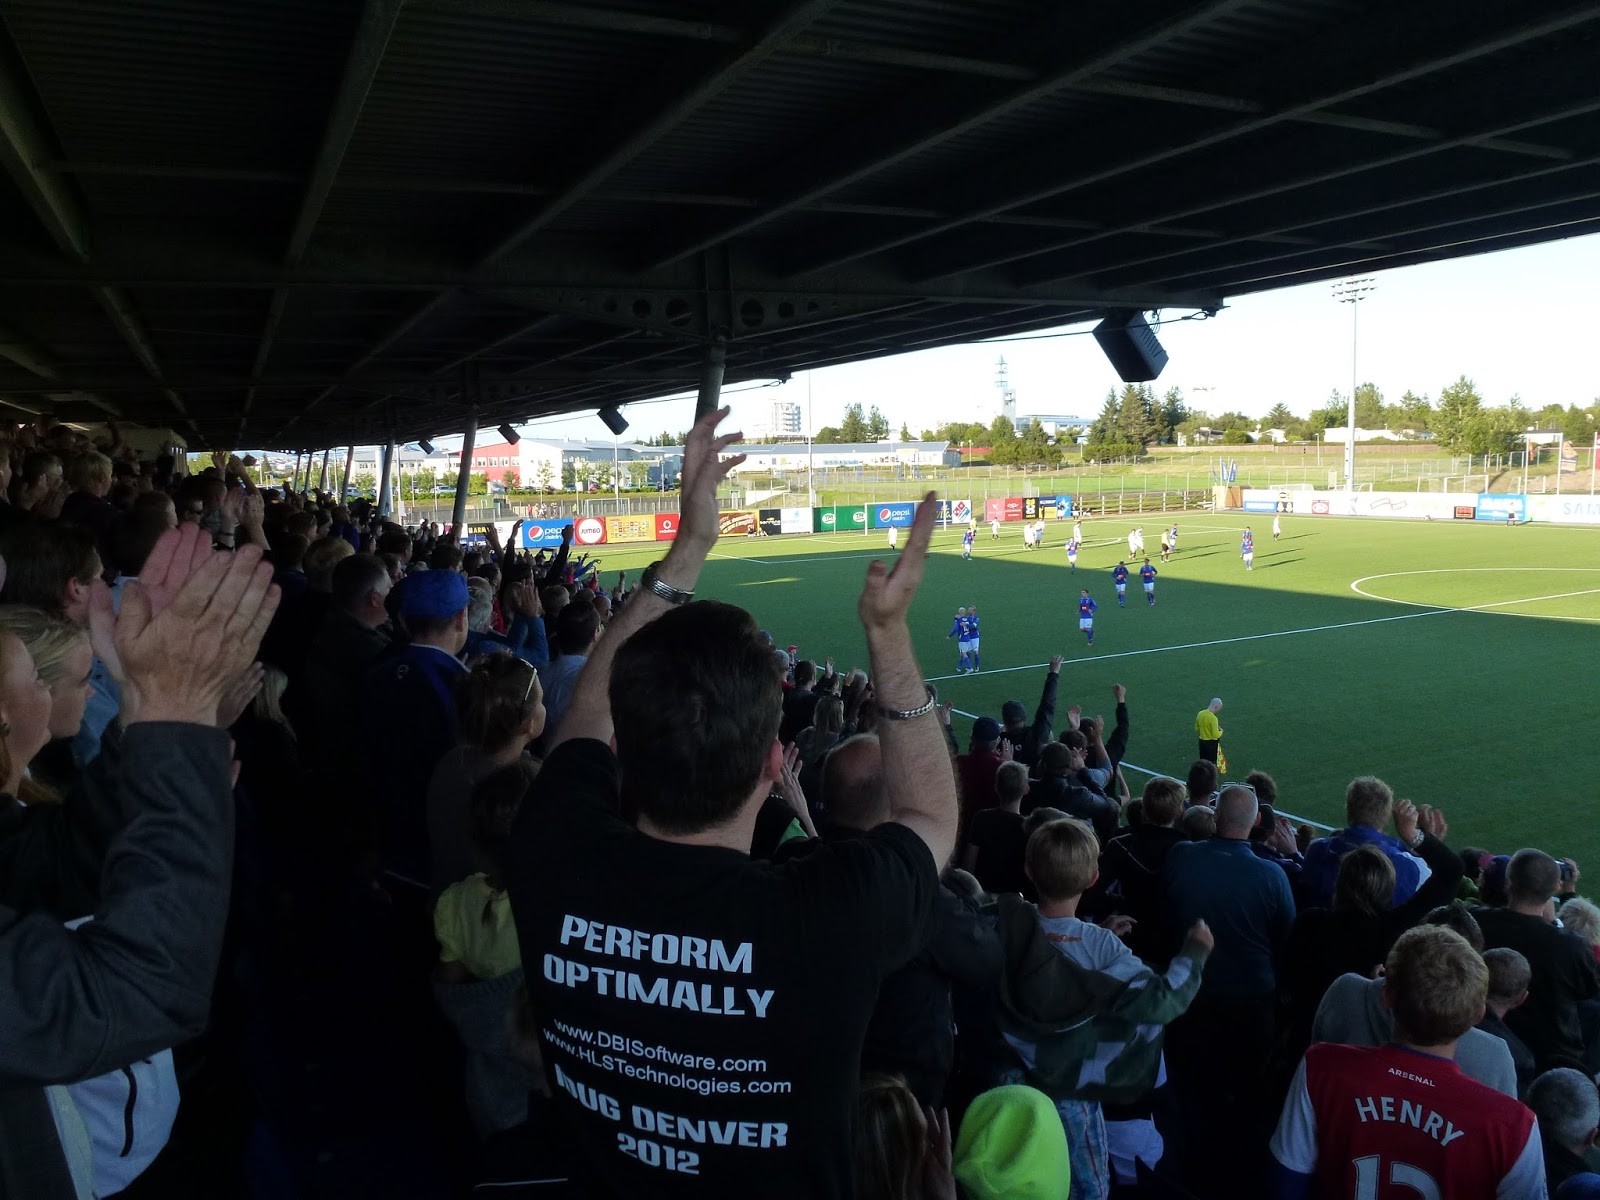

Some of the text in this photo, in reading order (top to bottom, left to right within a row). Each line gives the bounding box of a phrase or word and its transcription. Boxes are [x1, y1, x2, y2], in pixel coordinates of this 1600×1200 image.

[892, 509, 910, 517] pepsi
[560, 914, 753, 974] PERFORM
[543, 953, 775, 1018] OPTIMALLY
[543, 1029, 792, 1096] www.HLSTechnologies.com
[554, 1019, 767, 1072] www.DBISoftware.com
[1388, 1067, 1436, 1087] ARSENAL
[631, 1105, 789, 1148] DENVER
[1354, 1096, 1465, 1147] HENRY
[616, 1132, 700, 1175] 2012
